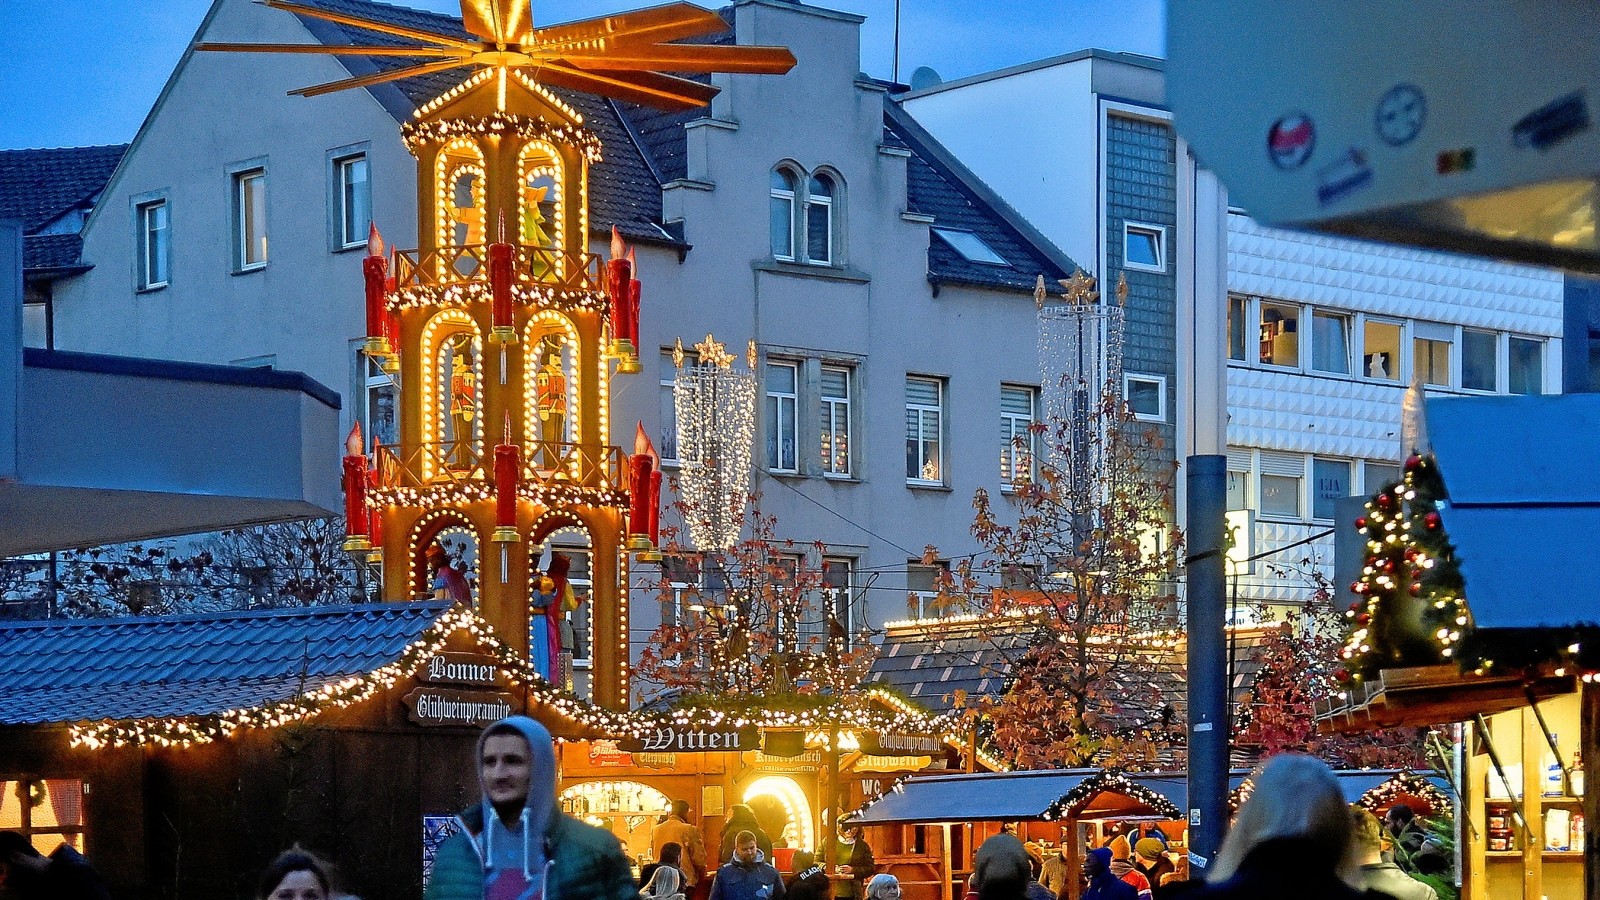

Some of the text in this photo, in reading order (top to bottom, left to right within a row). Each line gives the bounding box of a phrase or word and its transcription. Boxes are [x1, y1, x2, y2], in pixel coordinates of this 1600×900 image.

[428, 655, 497, 682] Bonner
[417, 694, 511, 724] Glühweinpyramide
[641, 727, 741, 750] Witten
[861, 779, 881, 795] WC
